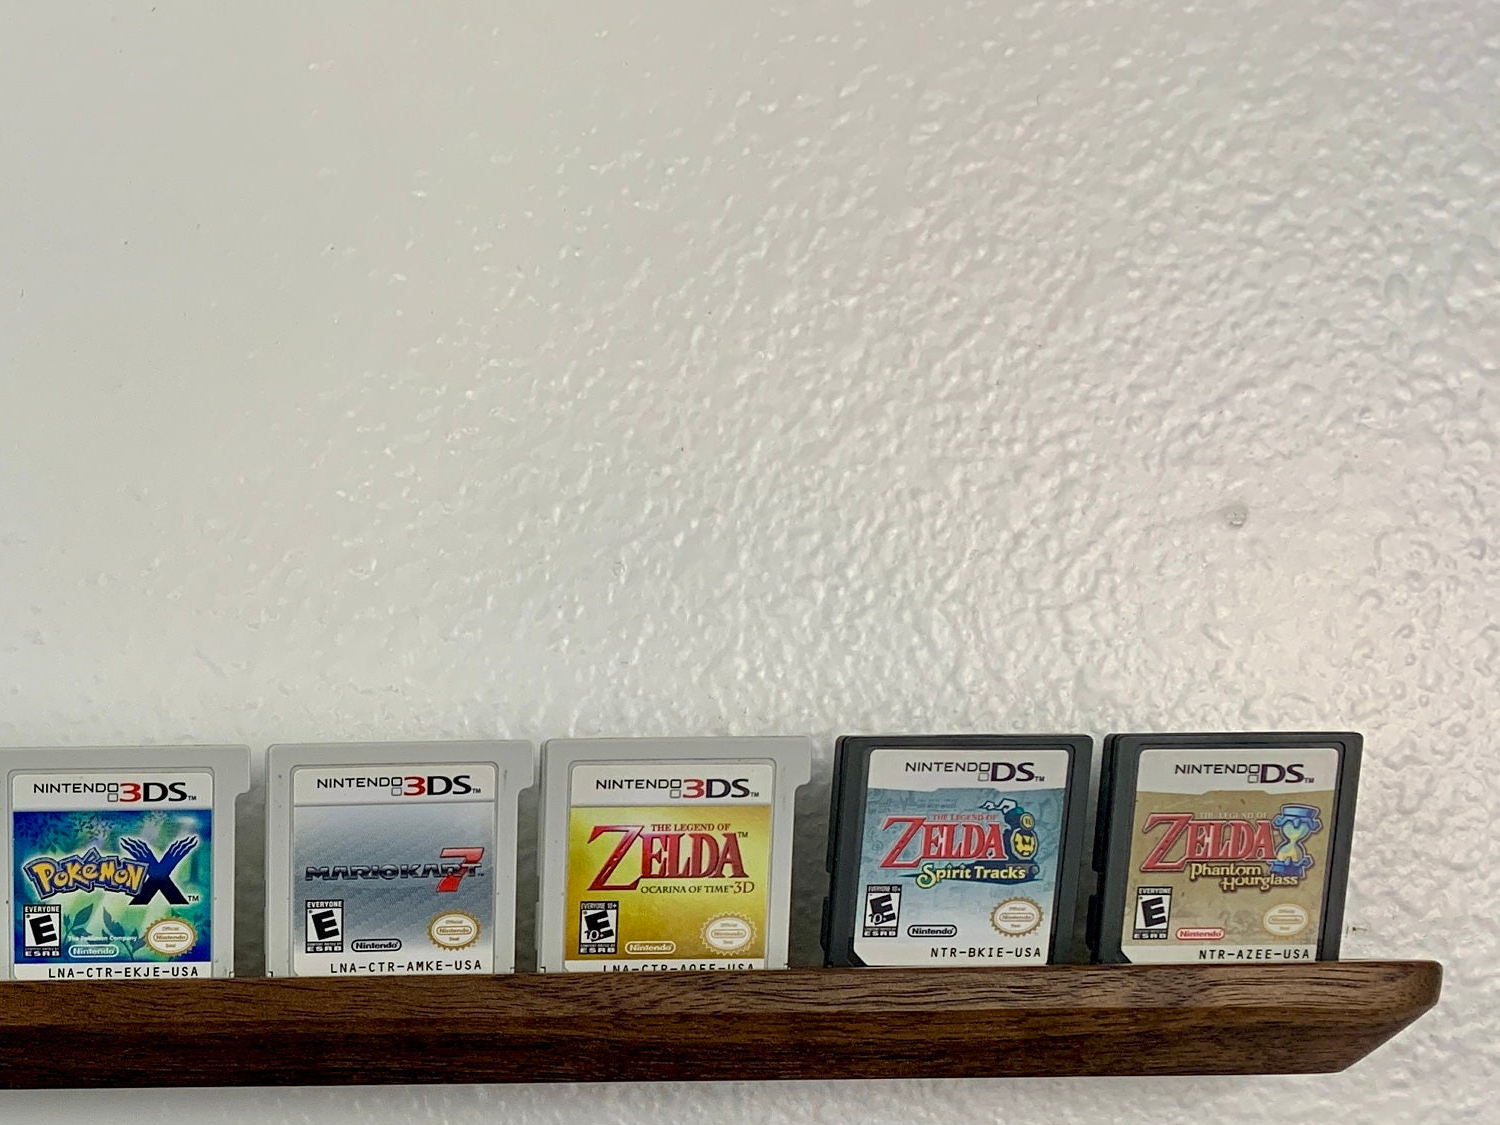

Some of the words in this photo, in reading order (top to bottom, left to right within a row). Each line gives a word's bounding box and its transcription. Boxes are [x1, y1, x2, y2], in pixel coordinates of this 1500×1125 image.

[906, 762, 990, 772] NINTENDO
[1175, 764, 1259, 774] NINTENDO
[34, 783, 118, 793] NINTENDO
[317, 777, 402, 788] NINTENDO
[596, 779, 681, 789] NINTENDO
[879, 816, 1007, 869] ZELDA
[1140, 813, 1278, 871] ZELDA
[587, 825, 749, 891] ZELDA
[916, 863, 971, 888] Spirit
[974, 866, 1026, 879] Tracks
[1190, 863, 1262, 881] Phantom
[641, 886, 686, 894] OCARINA
[734, 881, 755, 894] 3D
[1220, 875, 1298, 892] Hourglass
[912, 927, 953, 935] Nintendo
[931, 948, 1041, 957] NTR-BKIE-USA
[1199, 949, 1309, 959] NTR-AZEE-USA
[331, 959, 482, 973] LNA-CTR-AMKE-USA
[49, 967, 198, 978] LNA-CTR-EKJE-USA
